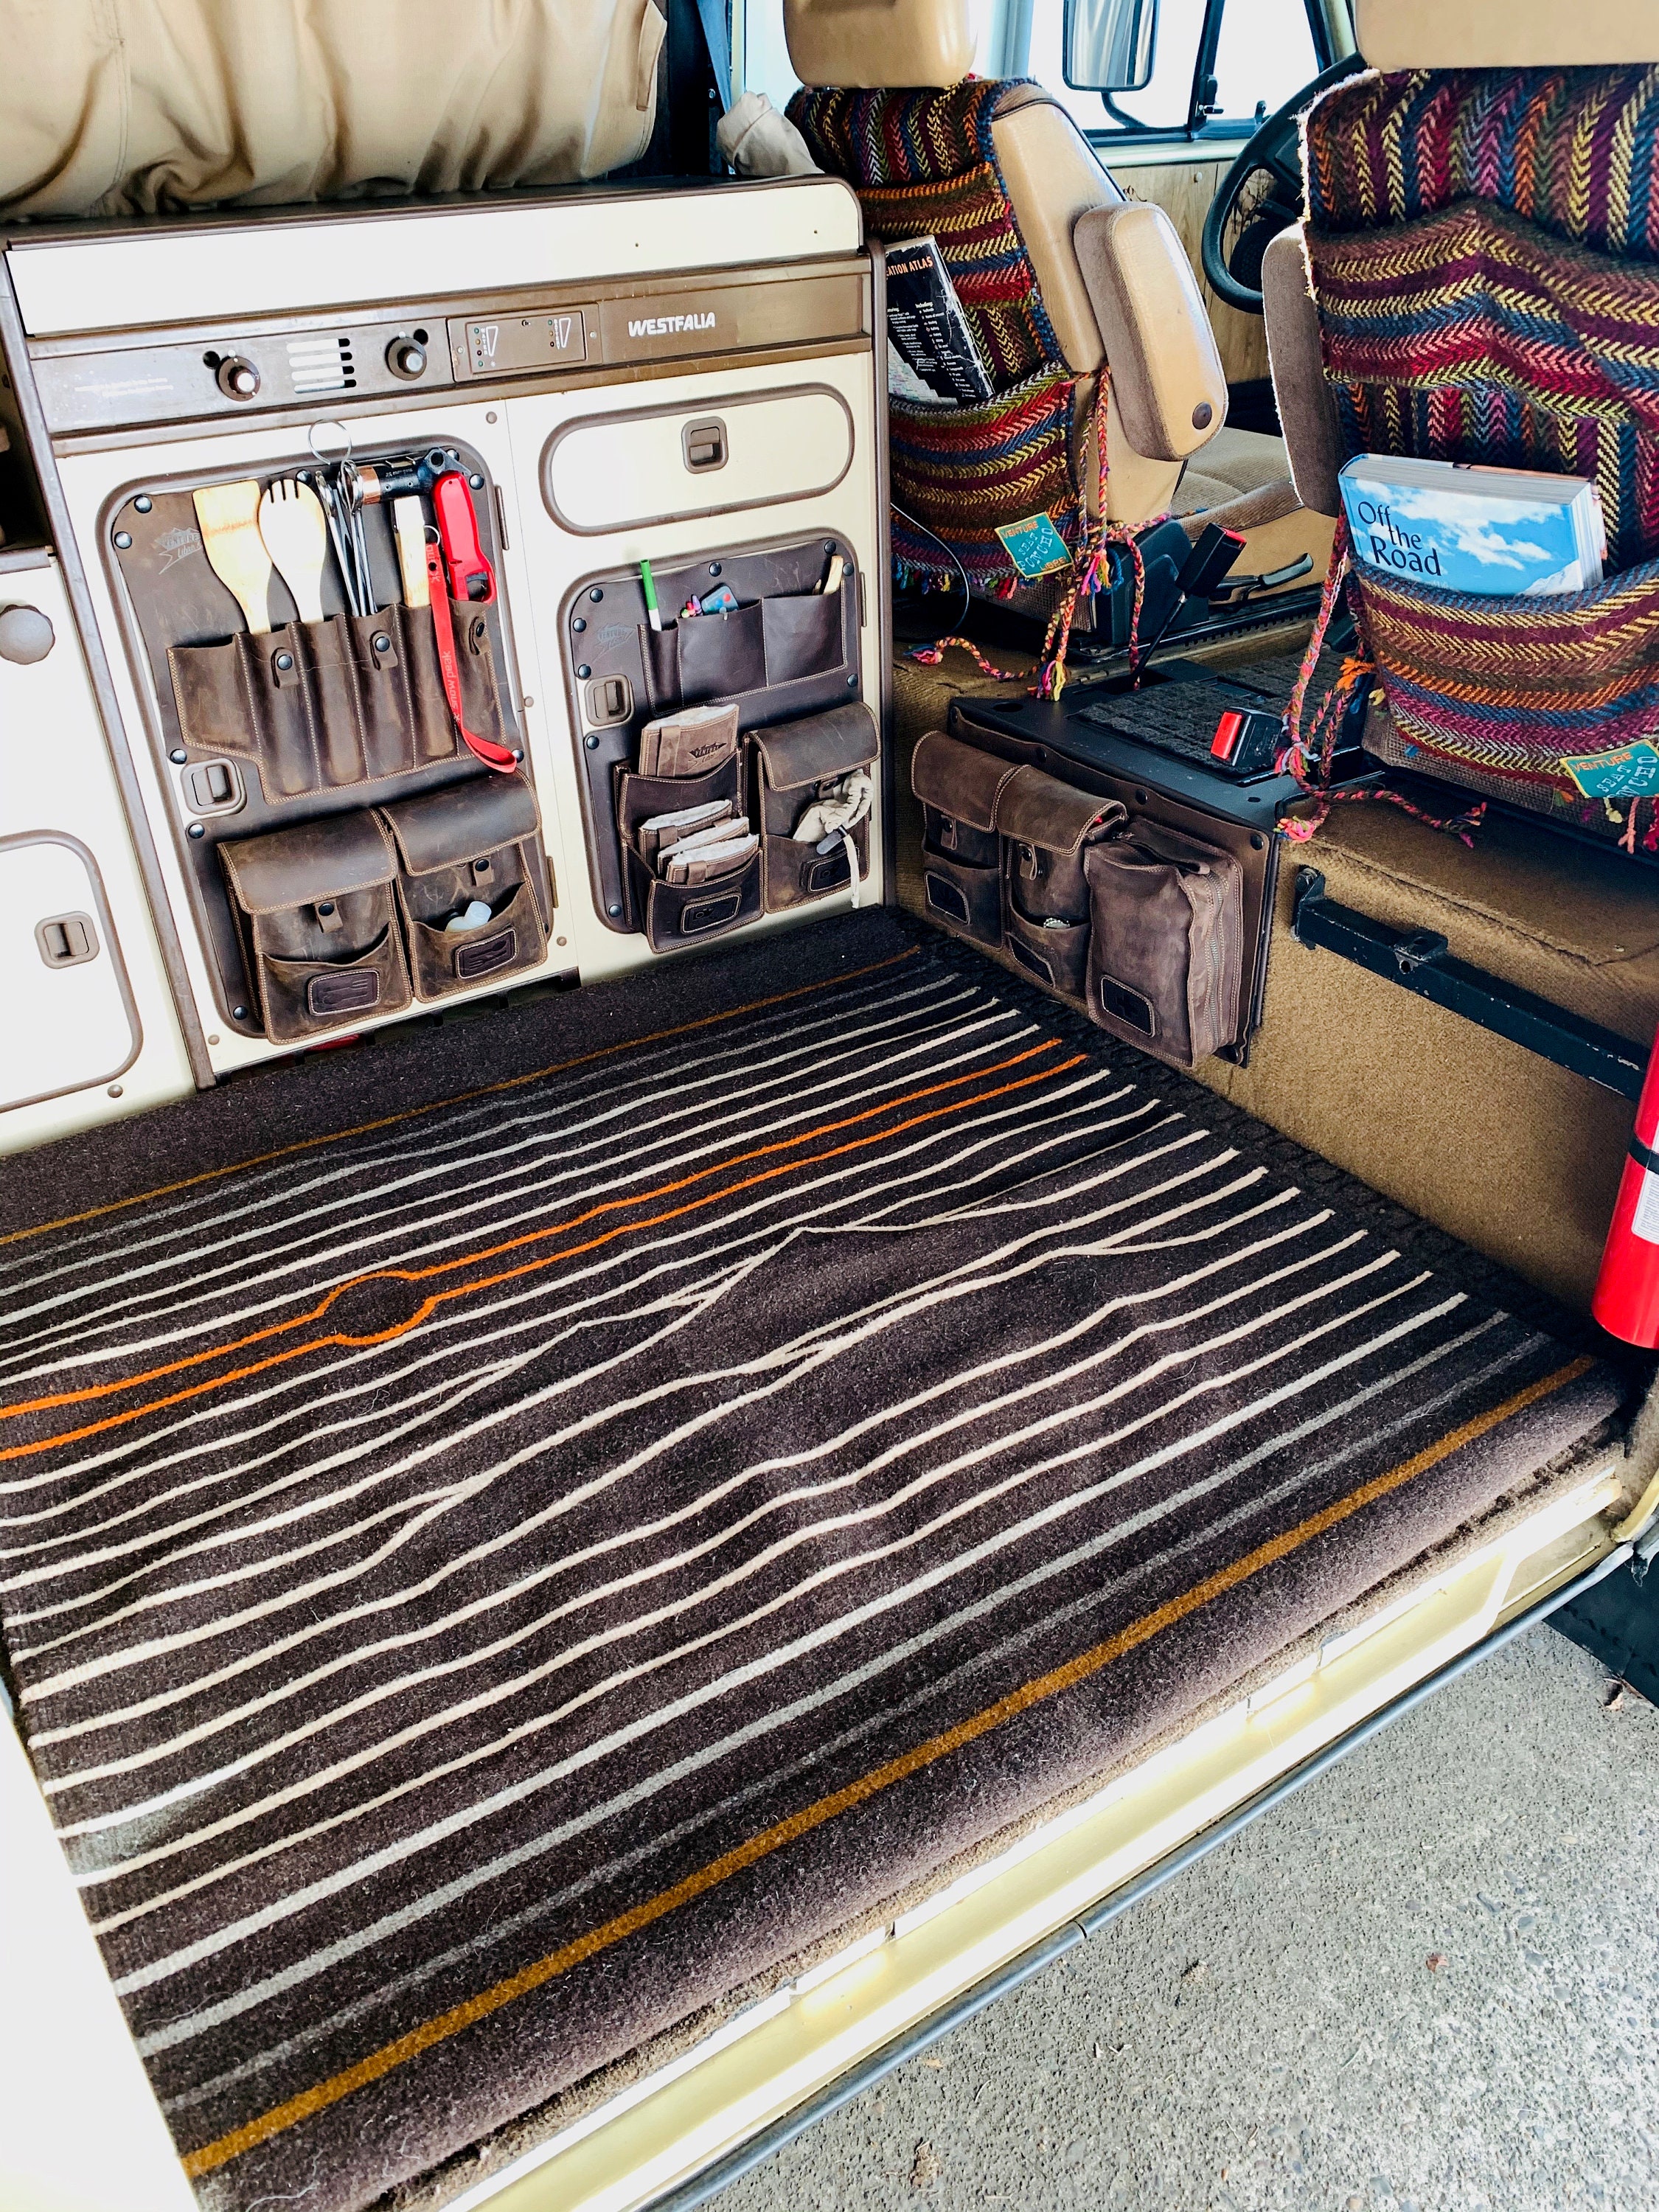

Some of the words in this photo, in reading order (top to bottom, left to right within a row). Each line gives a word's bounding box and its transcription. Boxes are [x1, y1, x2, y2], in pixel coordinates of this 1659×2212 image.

[909, 256, 933, 272] ATLAS
[627, 311, 716, 337] WESTFALIA
[480, 327, 488, 355] WATER
[1357, 501, 1391, 528] Off
[164, 533, 201, 547] VENTURE
[1001, 521, 1038, 539] VENTURE
[1388, 524, 1423, 550] the
[1017, 527, 1054, 571] PONCHO
[1018, 532, 1038, 555] SEAT
[1370, 535, 1441, 576] Road
[442, 650, 456, 678] peak
[447, 679, 459, 712] snow
[1571, 752, 1634, 773] VENTURE
[1596, 765, 1632, 793] SEAT
